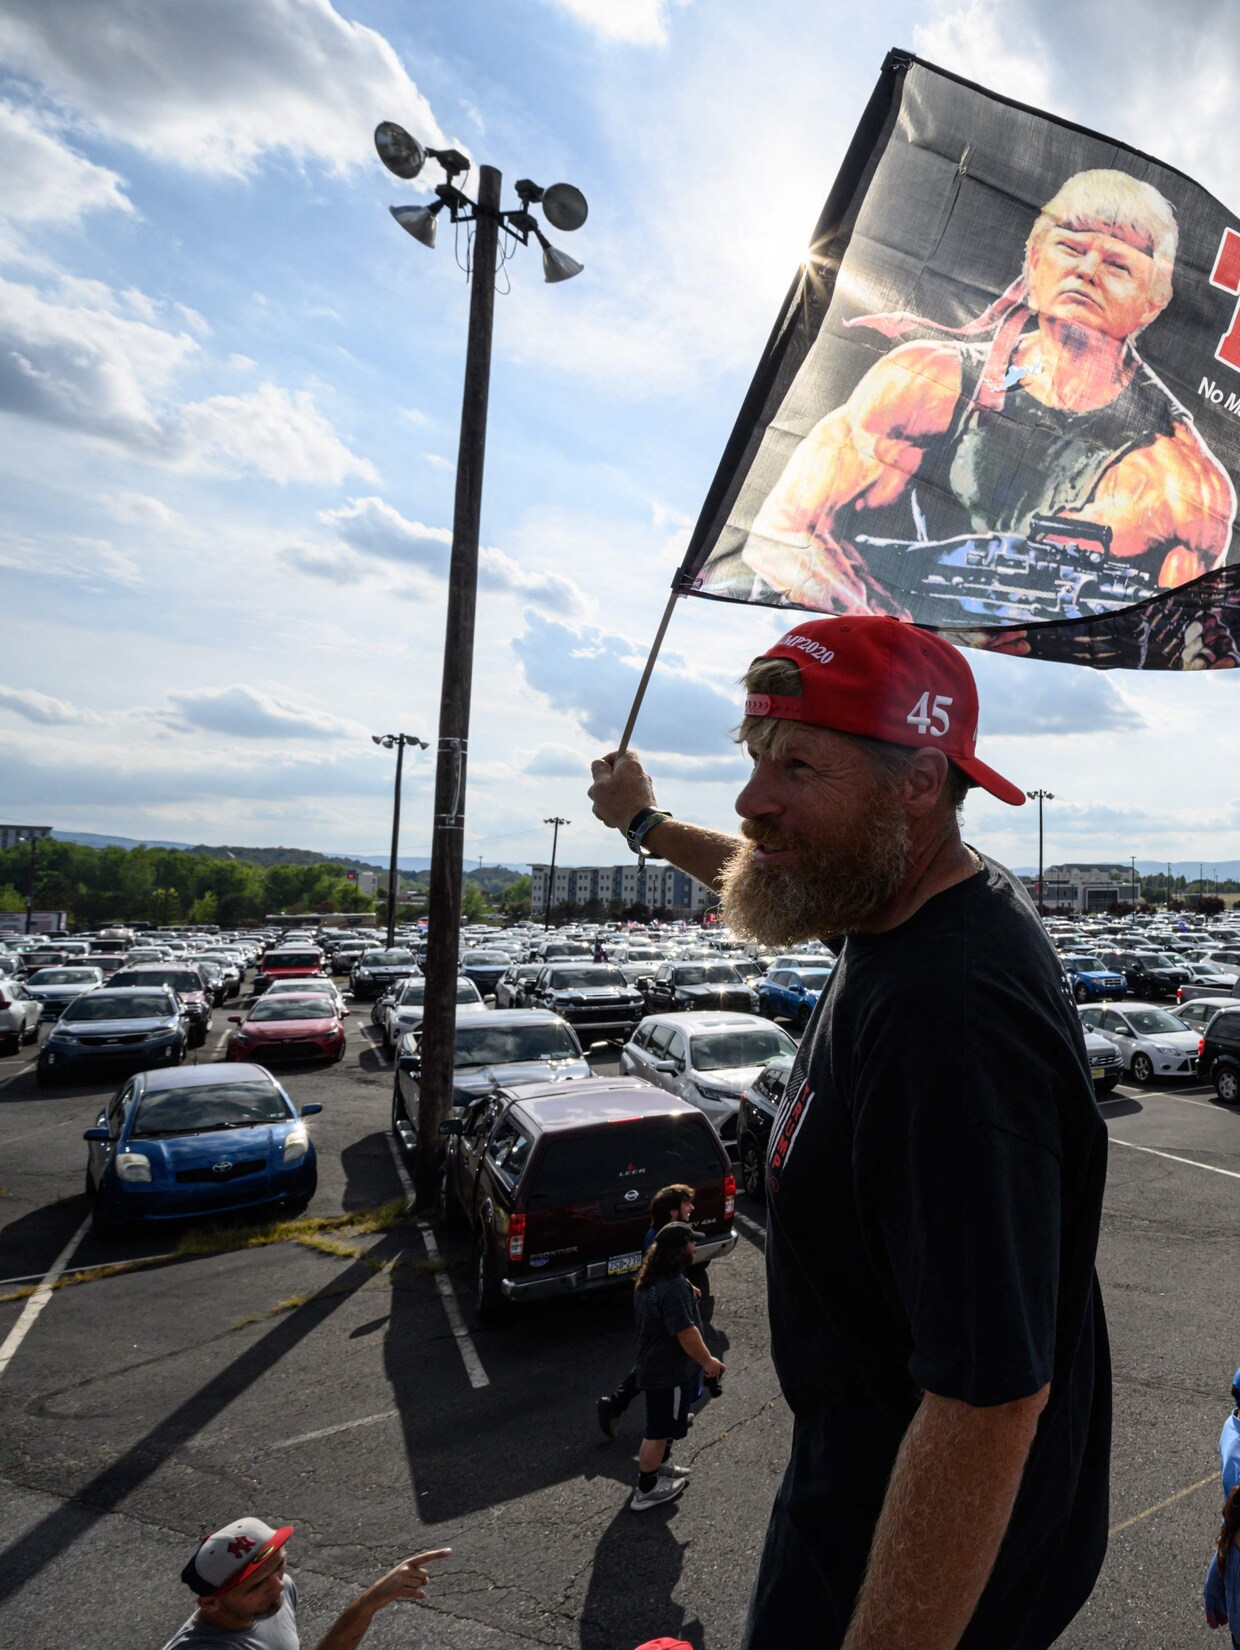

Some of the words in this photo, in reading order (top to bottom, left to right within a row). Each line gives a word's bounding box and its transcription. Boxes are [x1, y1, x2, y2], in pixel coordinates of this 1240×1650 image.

[1198, 376, 1223, 403] No
[907, 692, 953, 737] 45
[771, 1082, 811, 1169] TRUMP
[619, 1168, 646, 1177] LEER
